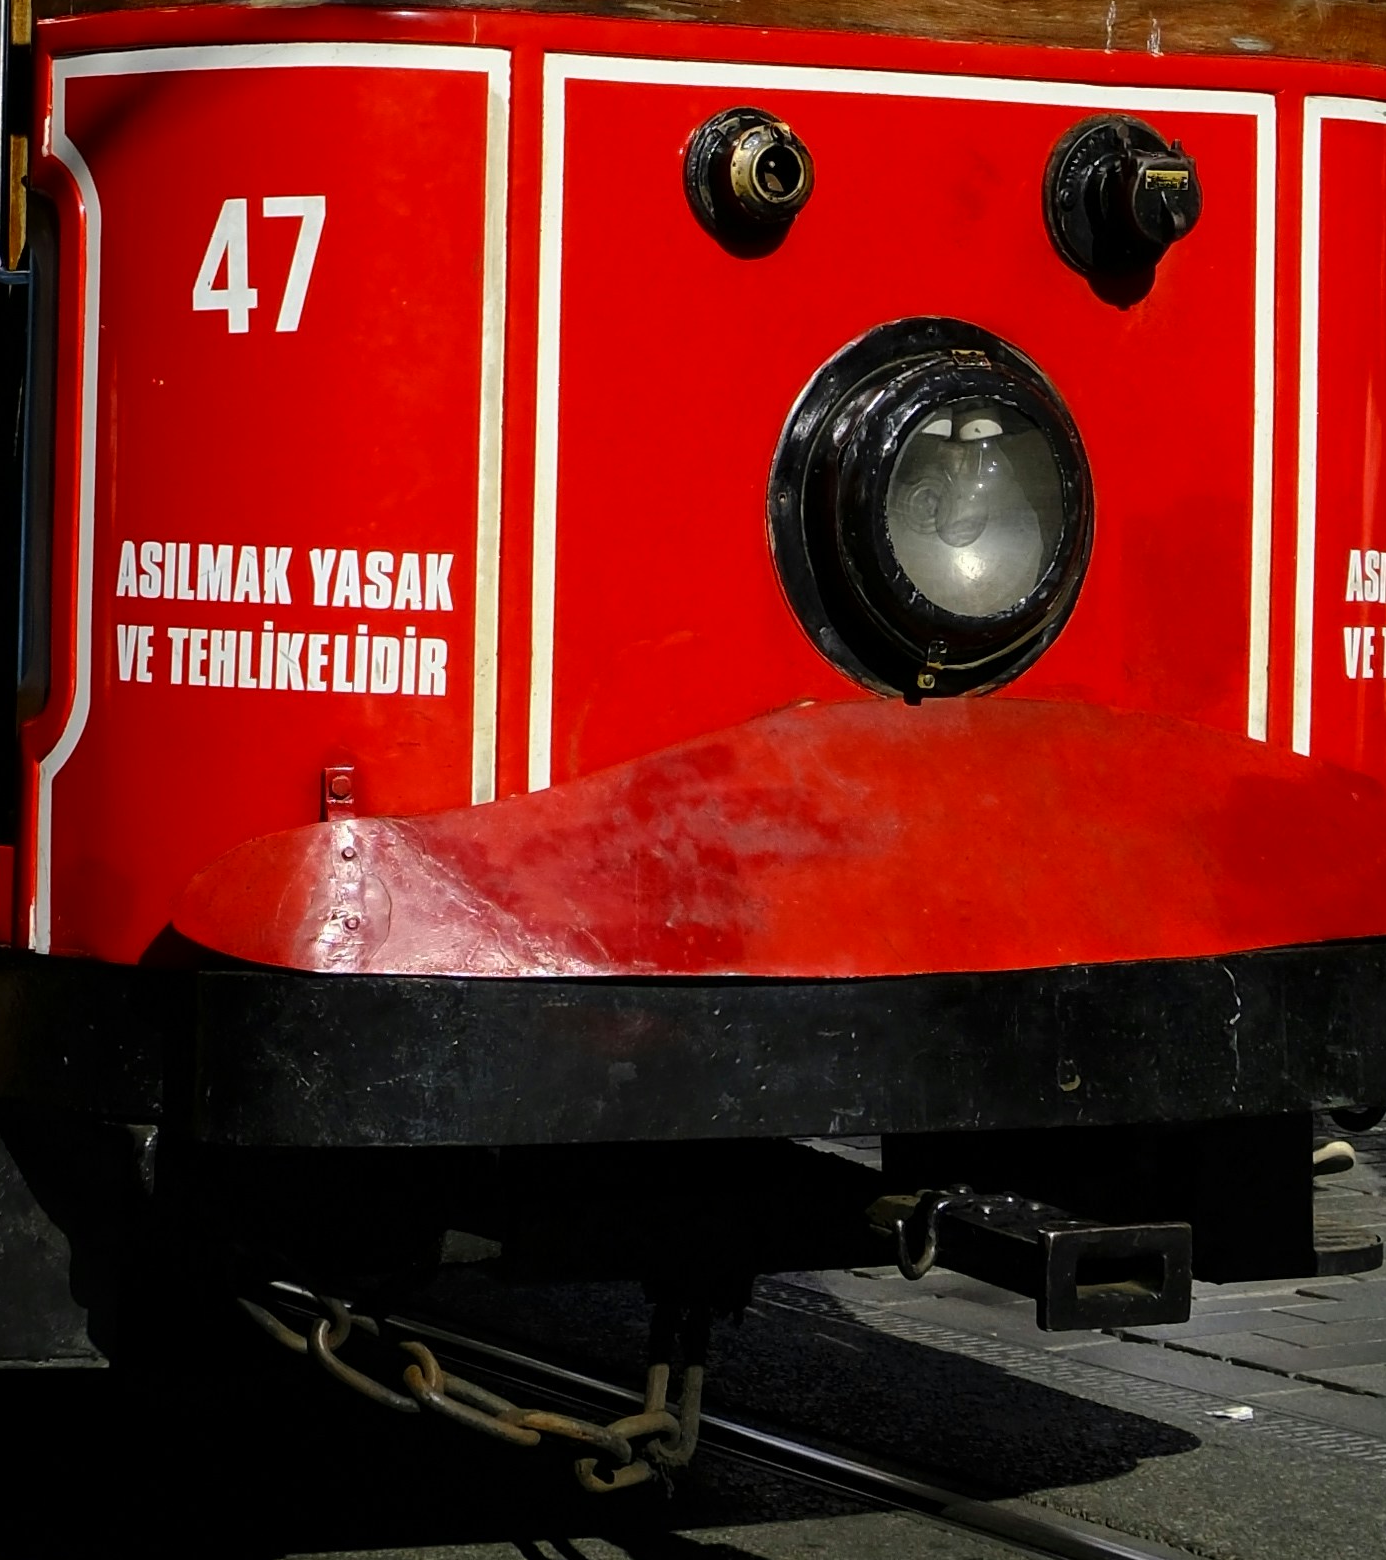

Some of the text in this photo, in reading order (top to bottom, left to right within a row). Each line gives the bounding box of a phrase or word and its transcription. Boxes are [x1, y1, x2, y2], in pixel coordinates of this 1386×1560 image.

[192, 195, 326, 334] 47
[116, 540, 454, 611] ASILMAK YASAK
[116, 620, 448, 696] VE TEHLİKELİDİR
[1343, 626, 1376, 679] VE
